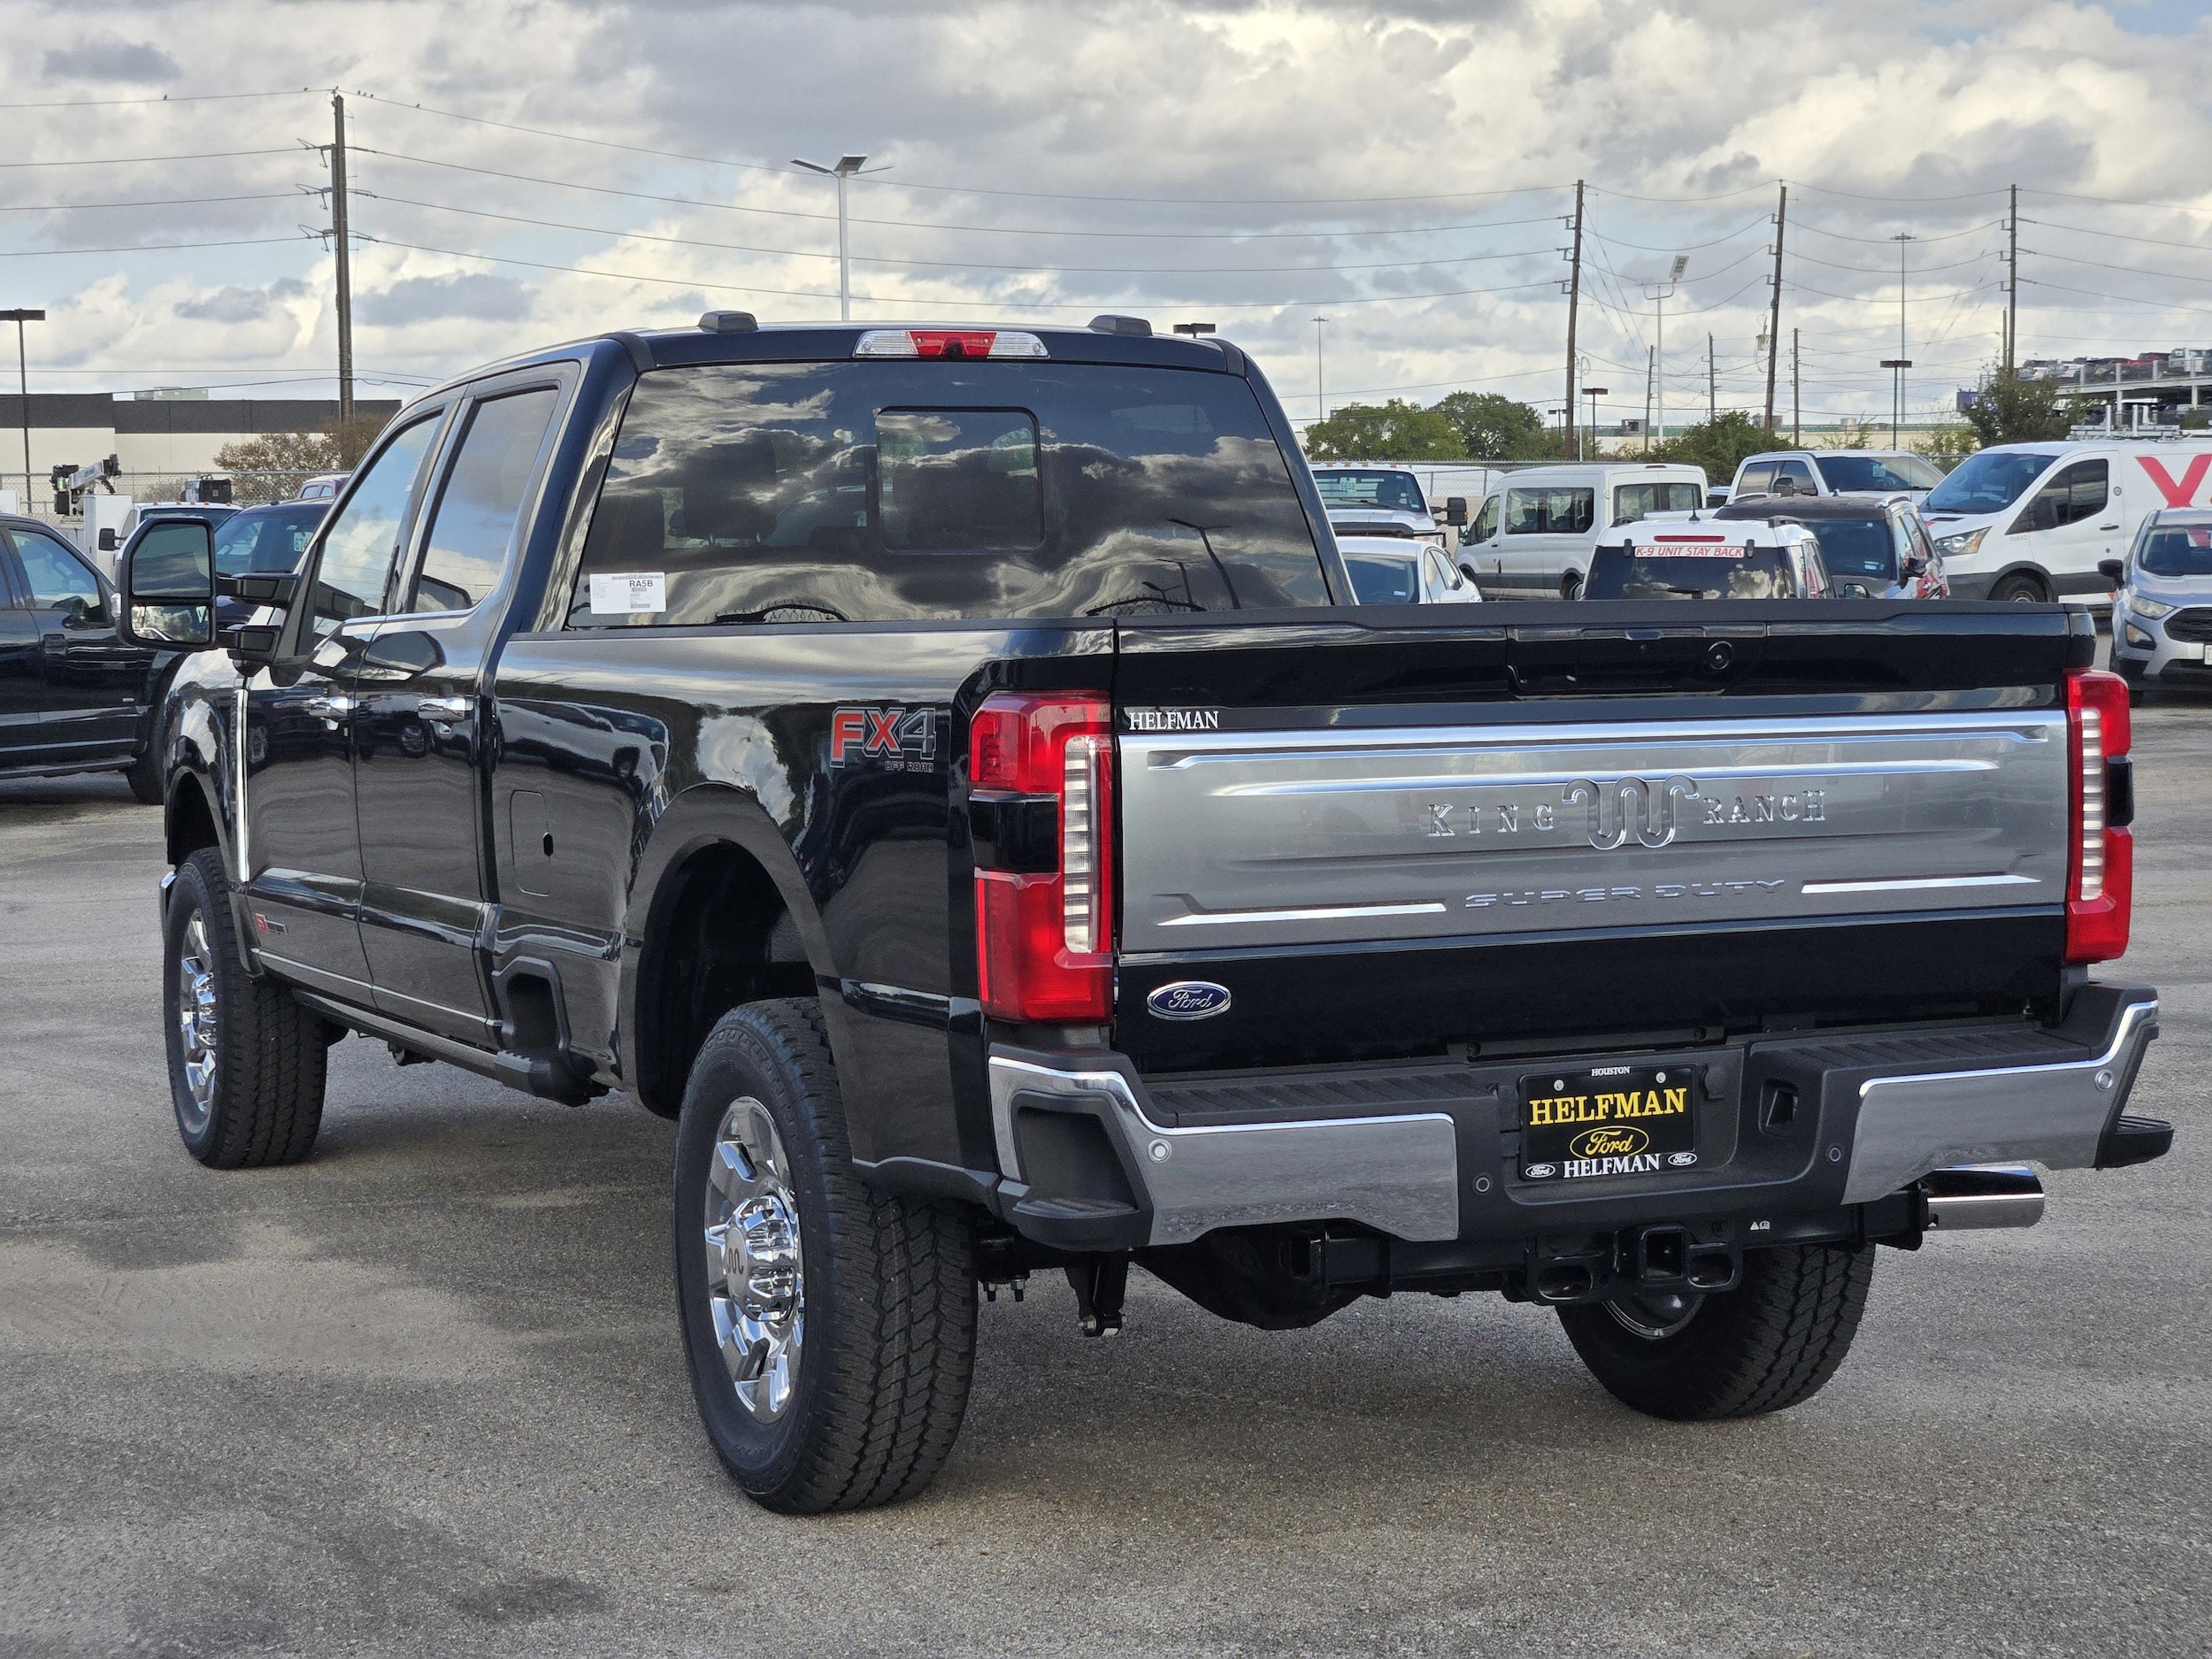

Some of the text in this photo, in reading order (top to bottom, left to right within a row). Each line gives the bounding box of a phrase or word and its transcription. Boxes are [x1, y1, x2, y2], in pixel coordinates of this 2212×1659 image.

[1636, 547, 1743, 557] K-9 UNIT STAY BACK
[1129, 710, 1219, 730] HELFMAN
[830, 706, 936, 768] FX4
[885, 761, 933, 772] OFF ROAD
[1427, 789, 1826, 837] KING RANCH
[1465, 879, 1785, 908] SUPER DUTY
[1167, 988, 1214, 1009] Ford
[1591, 1066, 1631, 1077] HOUSTON
[1528, 1087, 1687, 1125] HELFMAN
[1585, 1130, 1634, 1156] Ford
[1563, 1153, 1661, 1179] HELFMAN
